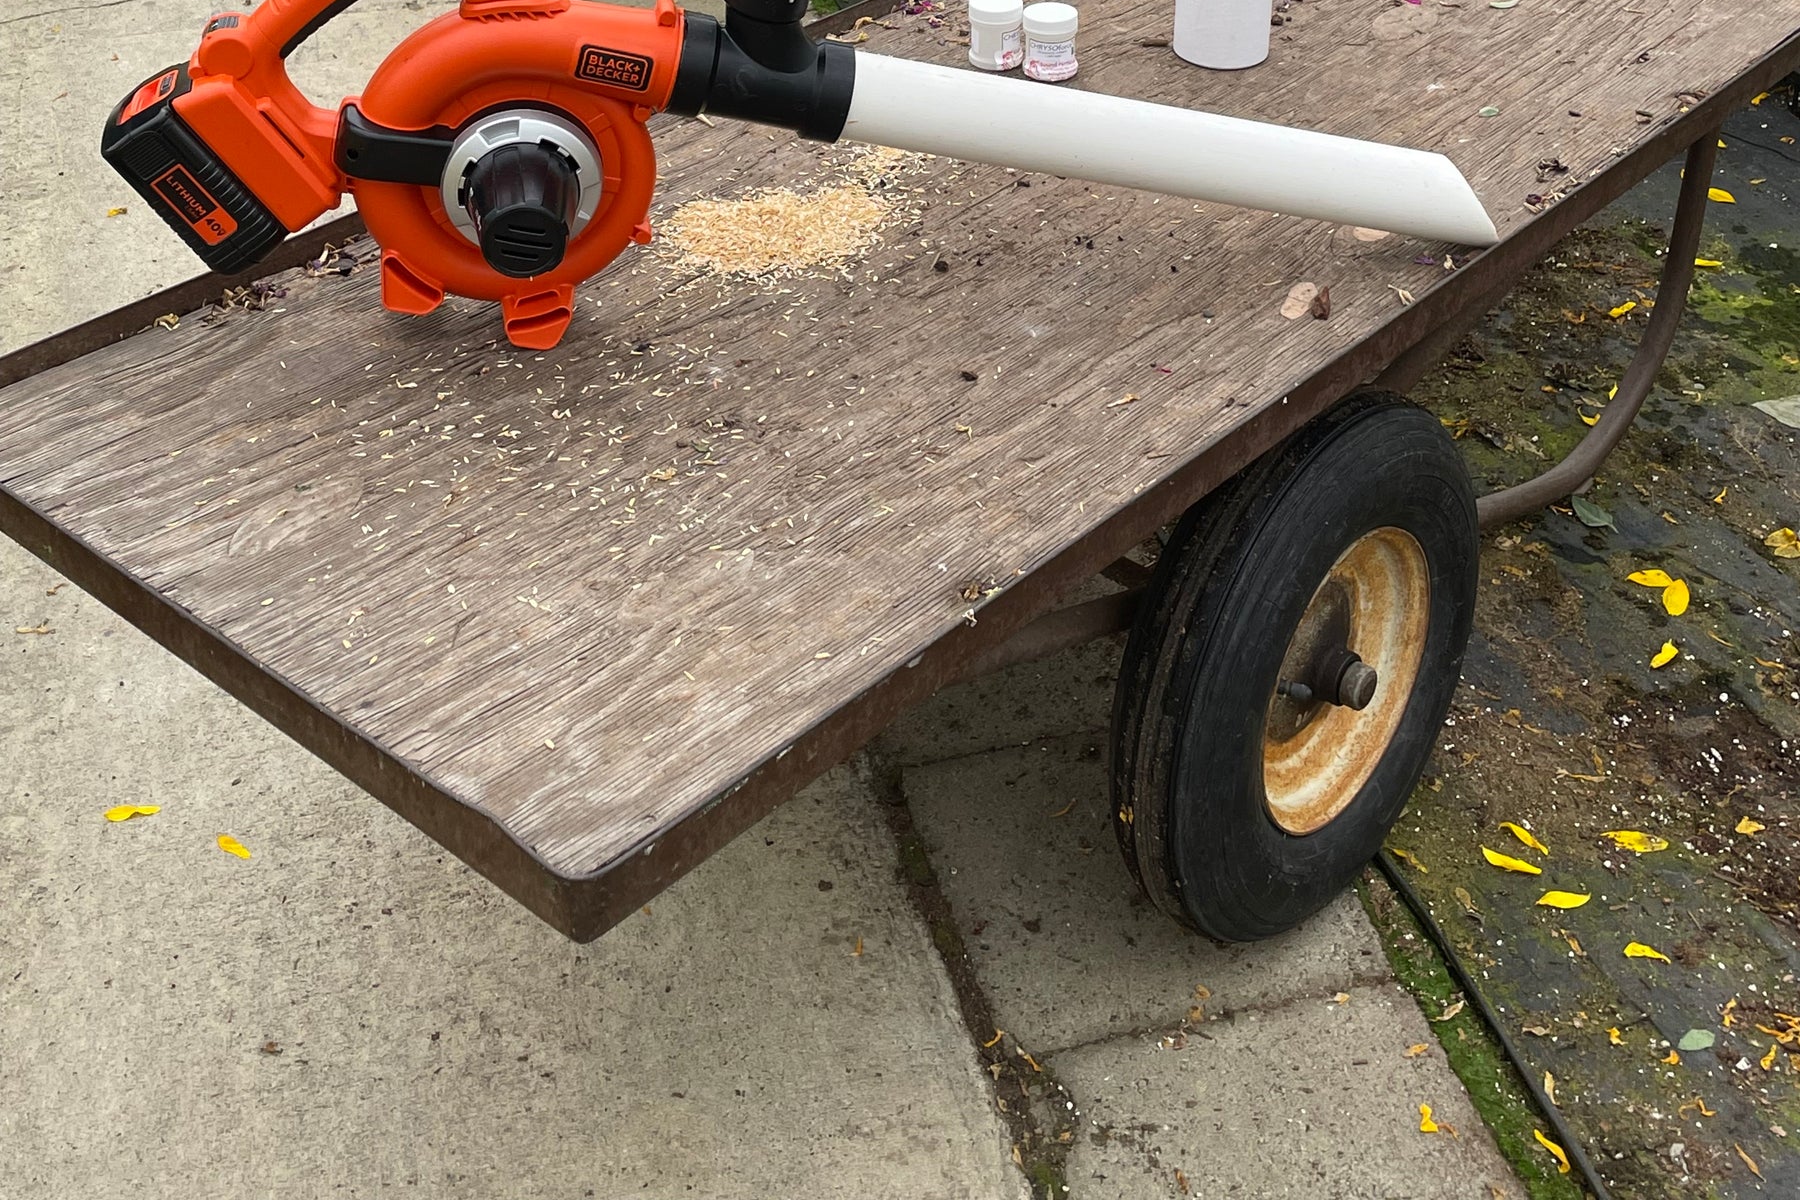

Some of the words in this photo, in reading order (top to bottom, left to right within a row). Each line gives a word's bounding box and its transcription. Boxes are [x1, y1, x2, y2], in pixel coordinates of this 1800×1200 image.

[589, 54, 640, 72] BLACK+
[586, 65, 639, 83] DECKER
[166, 176, 207, 216] LITHIUM
